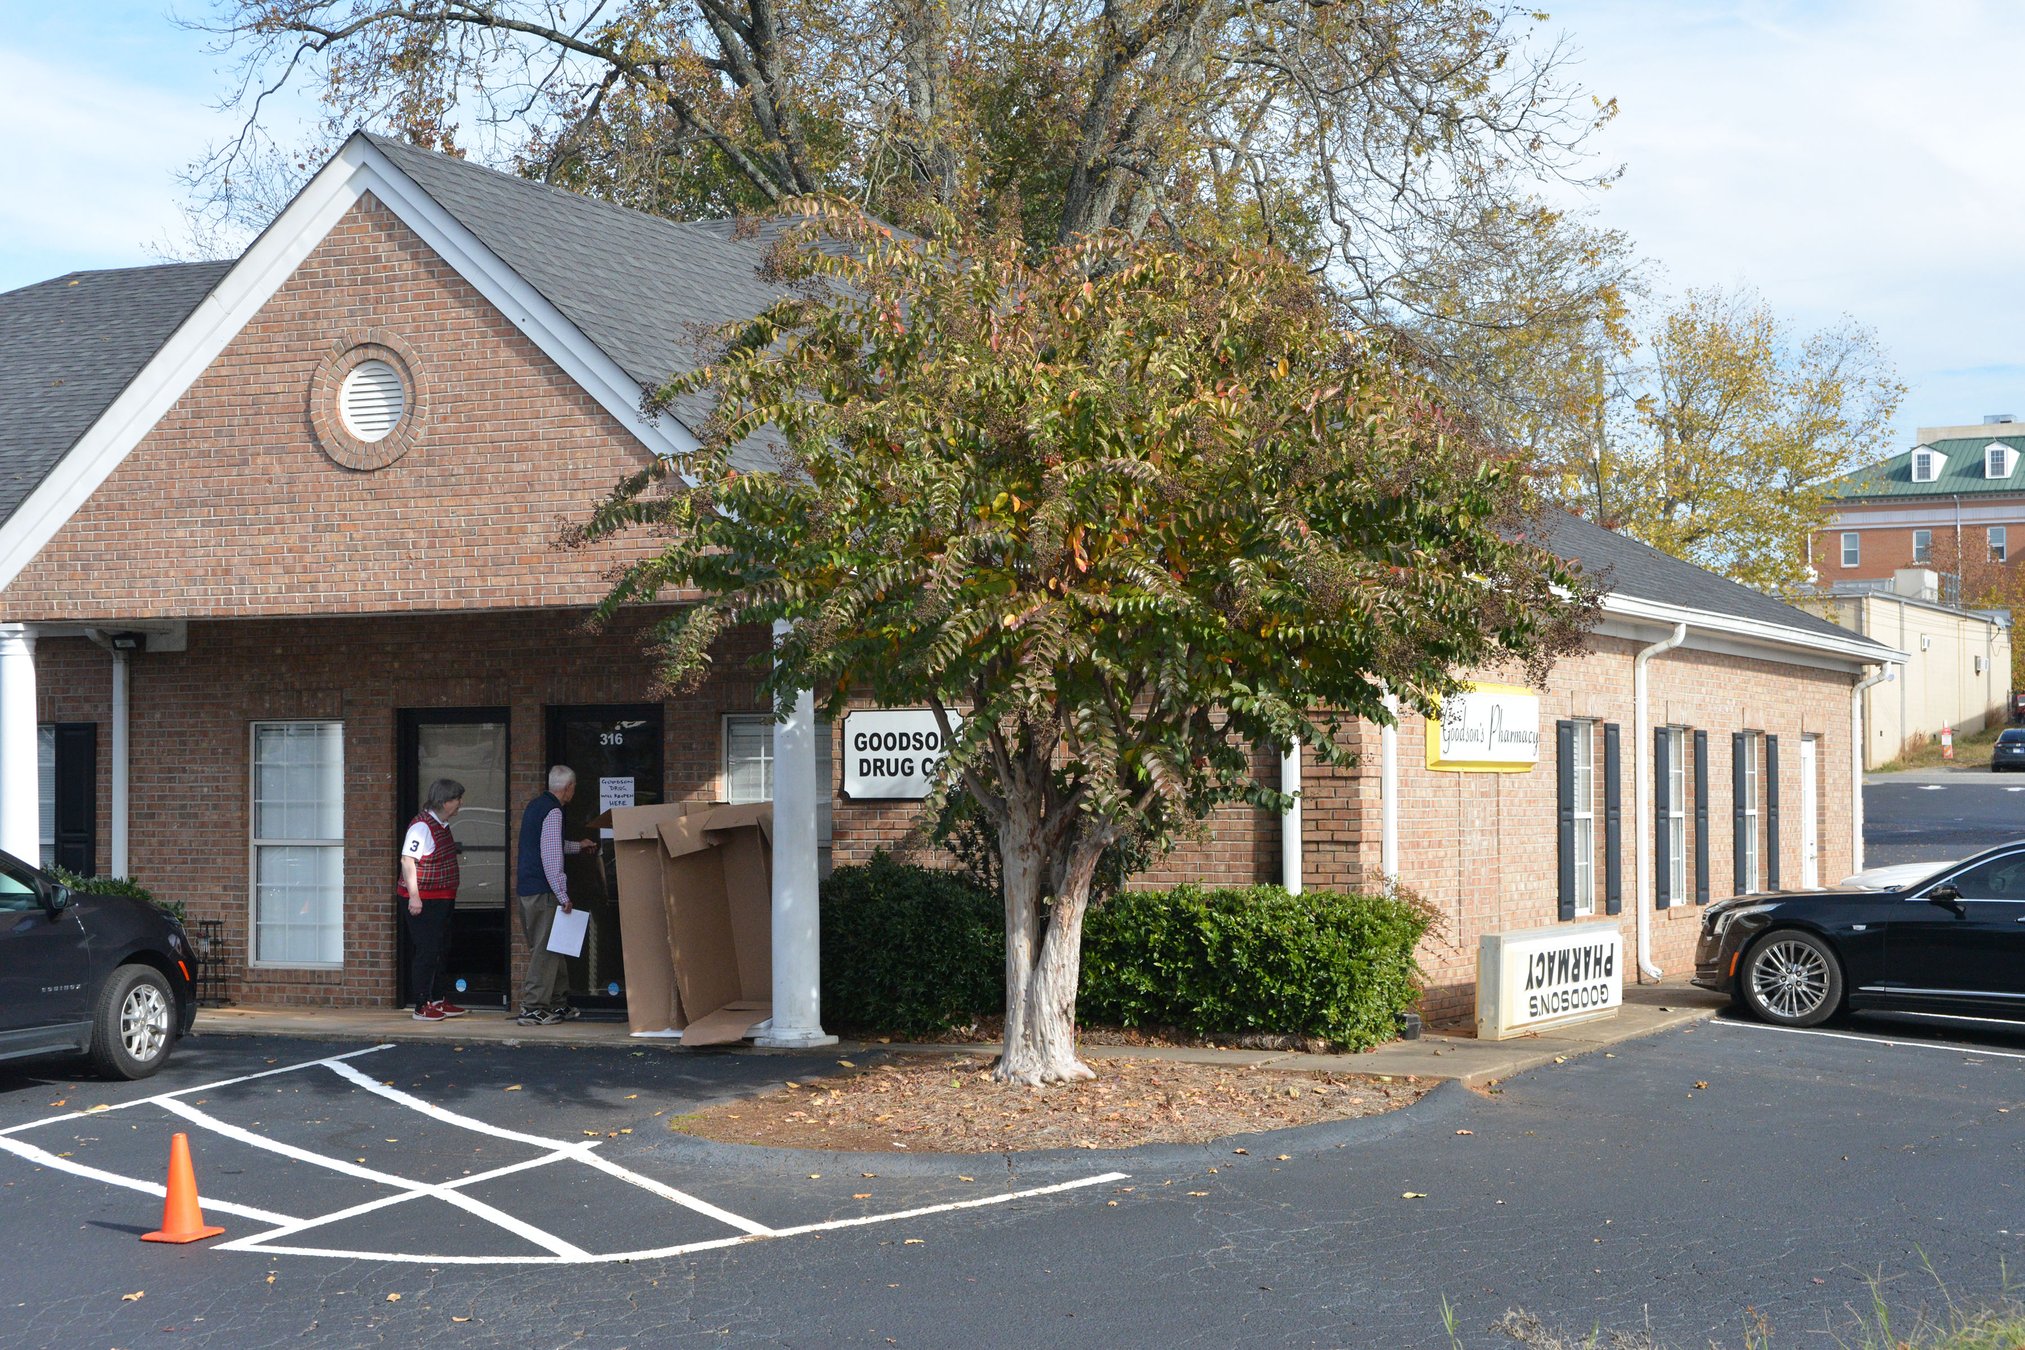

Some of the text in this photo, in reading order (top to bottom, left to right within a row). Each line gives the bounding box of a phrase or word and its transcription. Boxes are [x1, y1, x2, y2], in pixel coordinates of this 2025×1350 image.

[600, 733, 623, 745] 316
[1488, 704, 1539, 756] Pharmacy
[859, 757, 914, 777] DRUG
[409, 839, 420, 852] 3
[1525, 942, 1614, 991] PHARMACY
[1529, 983, 1609, 1017] GOODSON'S
